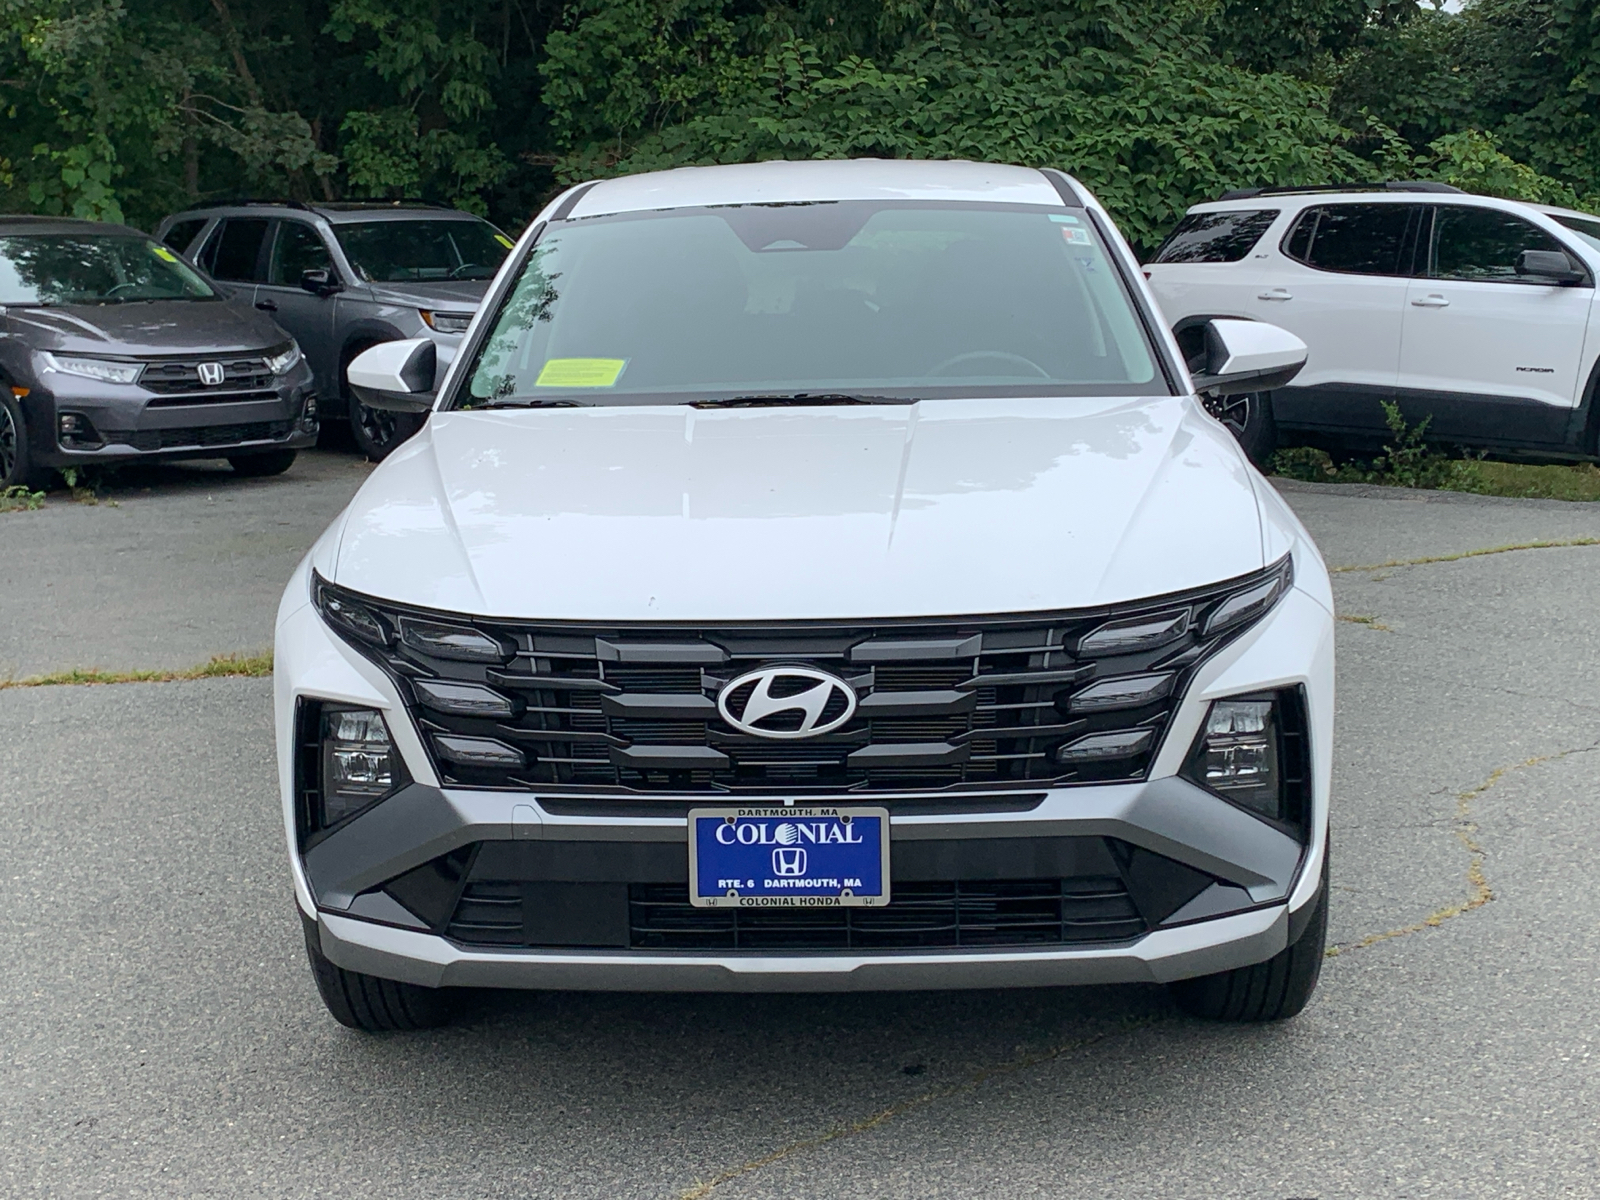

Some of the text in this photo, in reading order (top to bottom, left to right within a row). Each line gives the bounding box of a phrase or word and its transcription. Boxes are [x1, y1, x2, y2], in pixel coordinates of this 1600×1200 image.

[738, 808, 838, 817] DARTMOUTH, MA
[715, 822, 863, 845] COLONIAL
[718, 878, 862, 889] RTE. 6 DARTMOUTH, MA
[739, 896, 841, 906] COLONIAL HONDA
